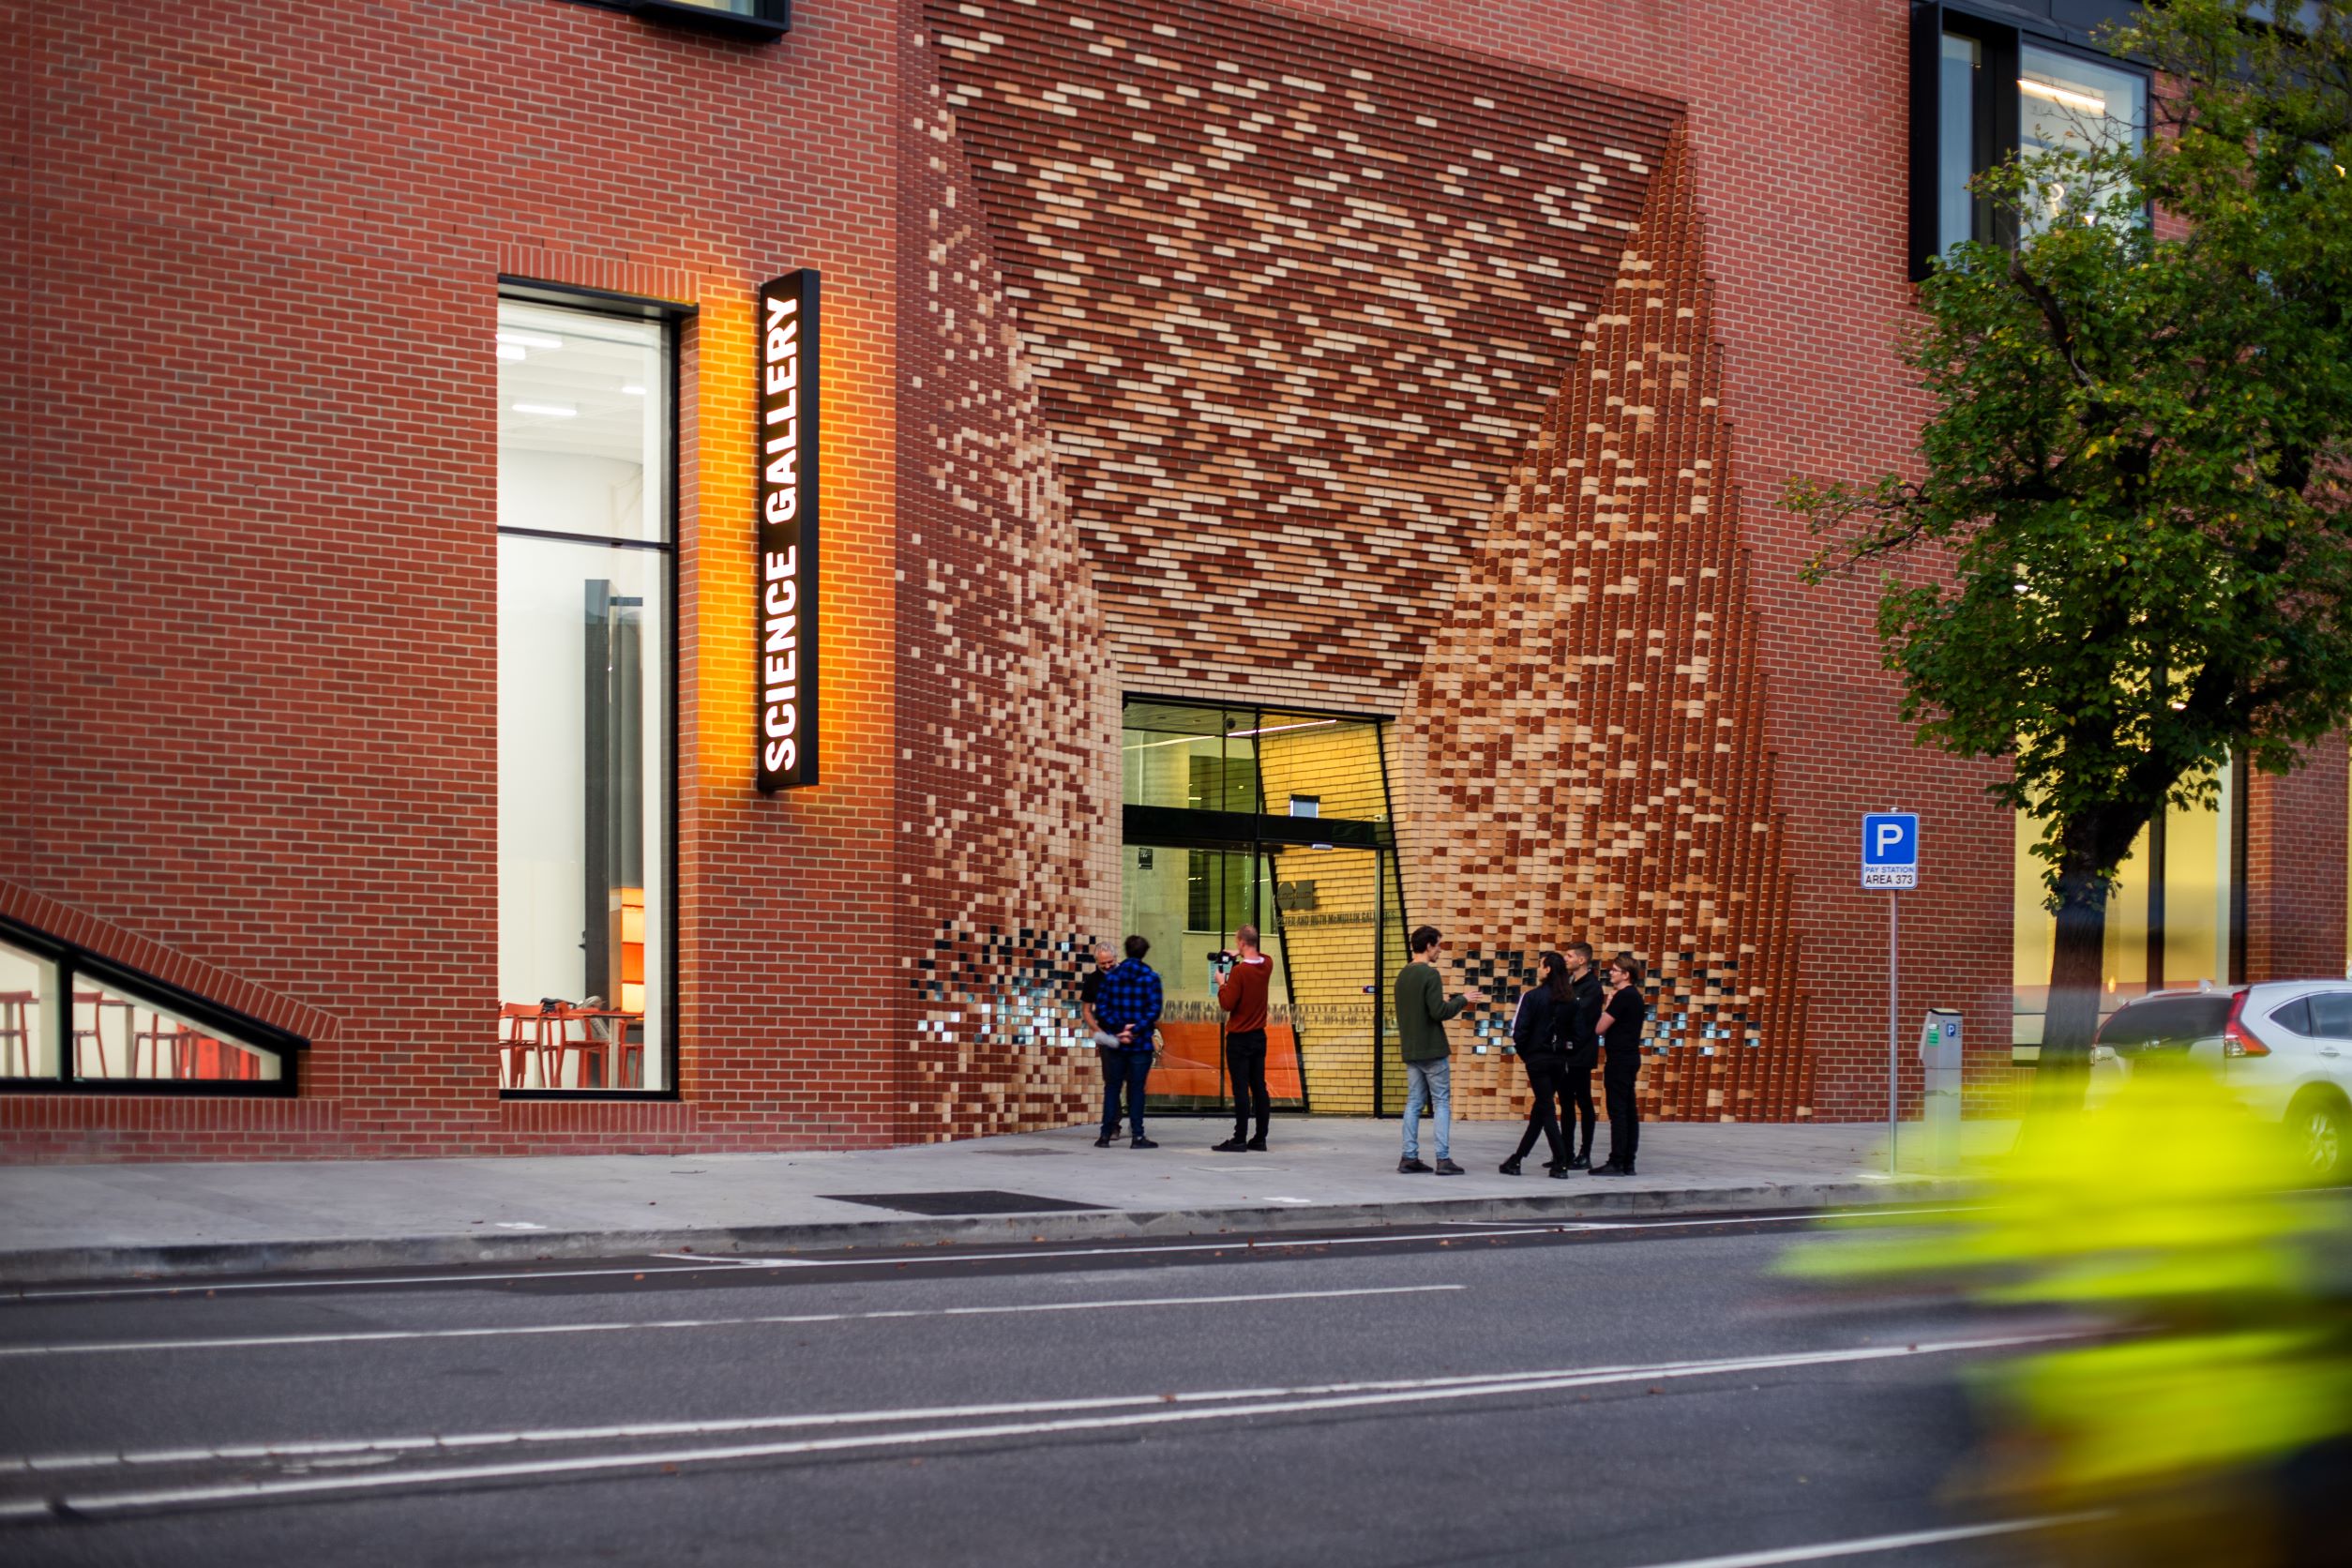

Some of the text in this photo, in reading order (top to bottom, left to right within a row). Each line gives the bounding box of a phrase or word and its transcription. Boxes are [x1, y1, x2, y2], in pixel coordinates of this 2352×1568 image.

[765, 297, 797, 772] SCIENCE GALLERY
[1877, 823, 1904, 857] P
[1865, 874, 1913, 884] AREA 373
[1948, 1025, 1955, 1036] P
